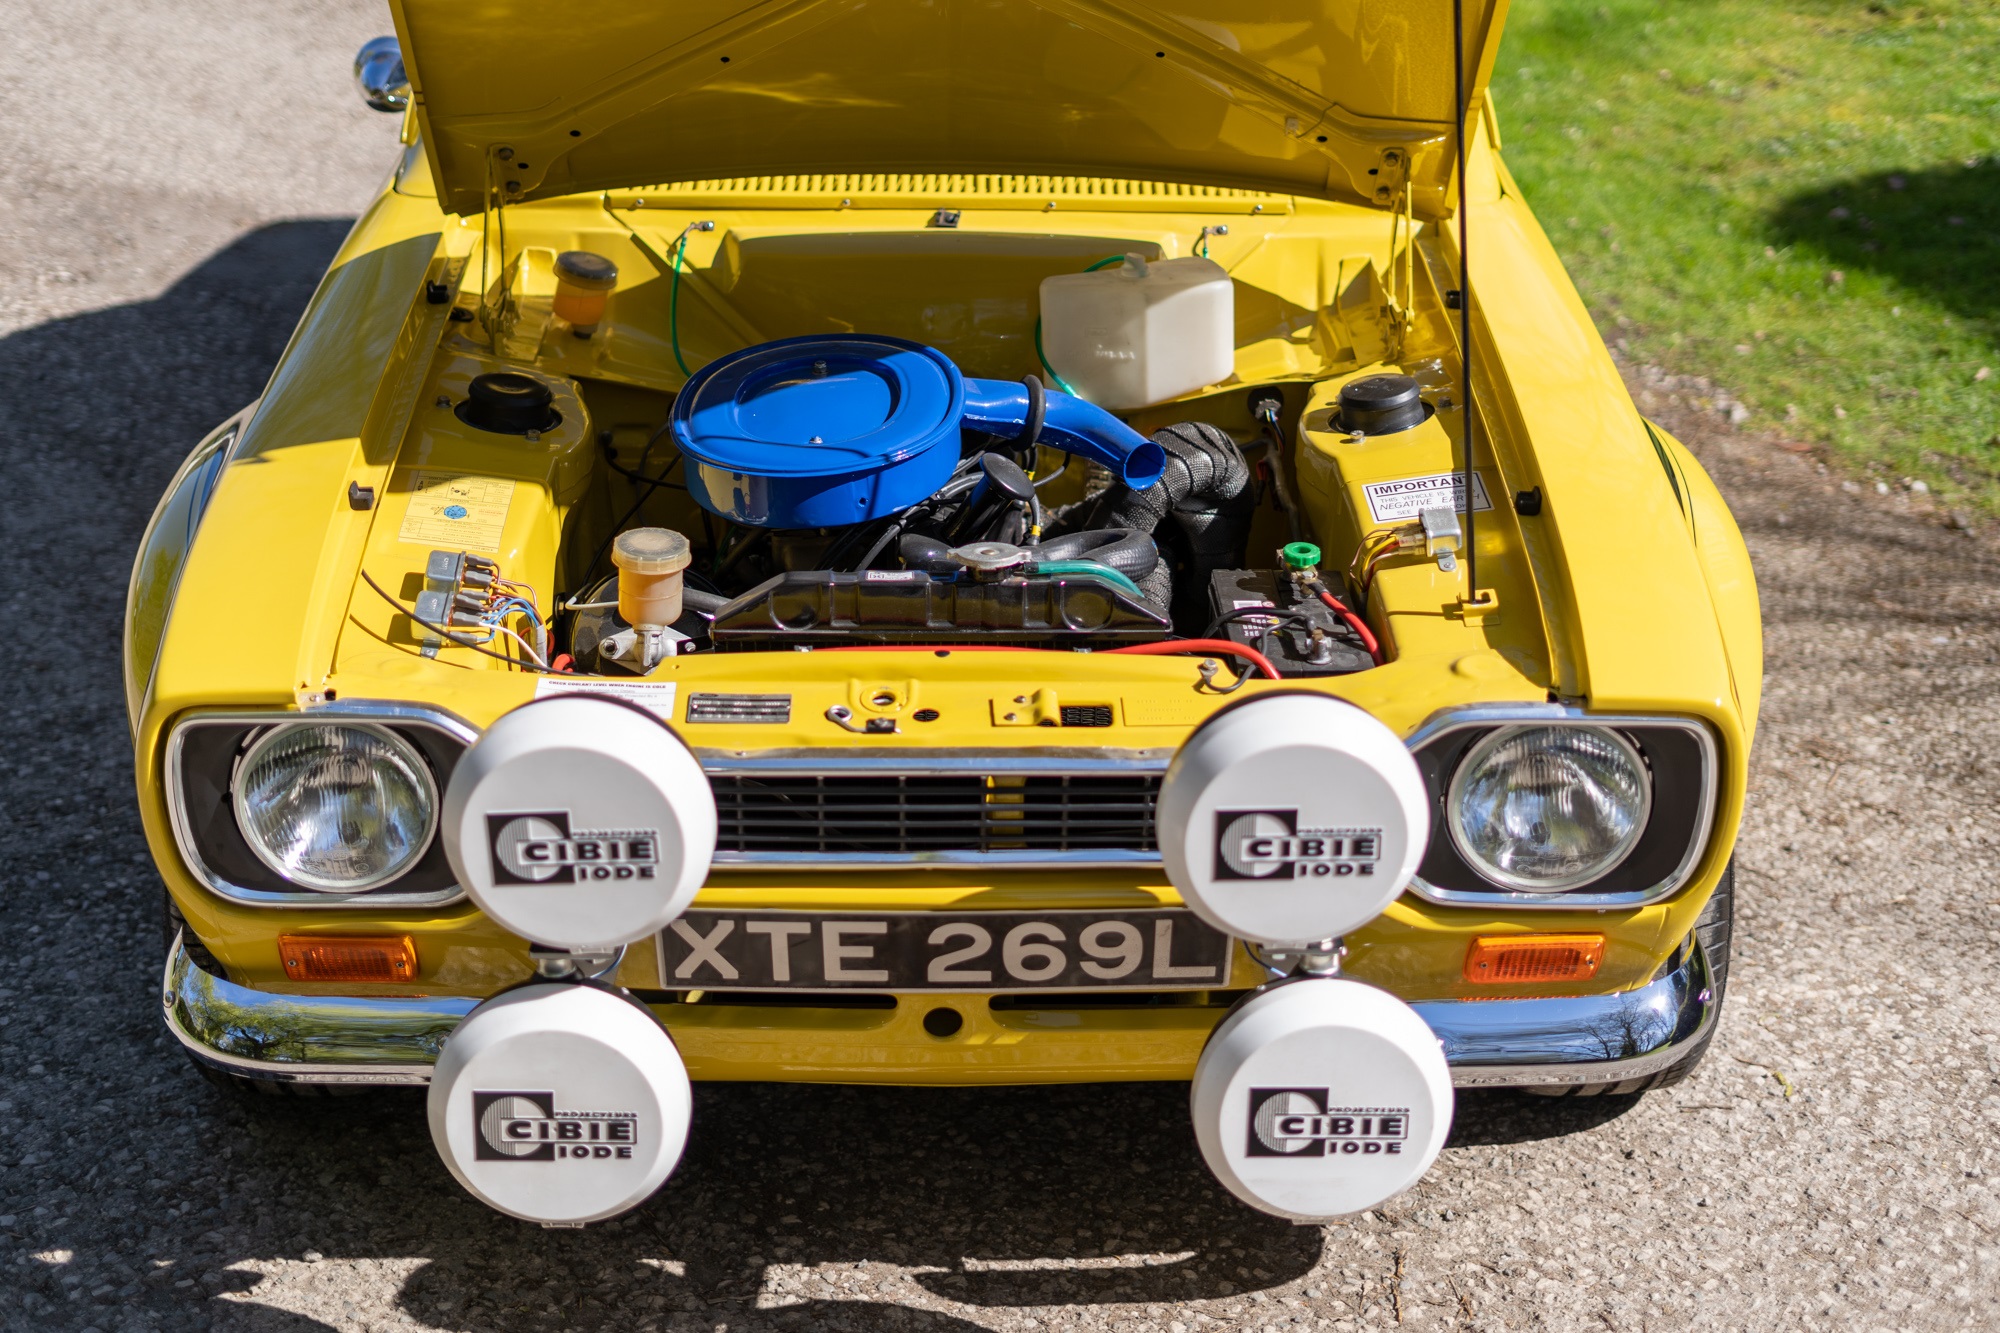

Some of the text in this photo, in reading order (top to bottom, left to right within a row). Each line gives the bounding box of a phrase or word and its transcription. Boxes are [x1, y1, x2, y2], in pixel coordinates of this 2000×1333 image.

[1380, 498, 1433, 511] NEGATIVE
[1403, 493, 1434, 502] VEHICLE
[579, 866, 655, 881] IODE
[1298, 863, 1375, 877] IODE
[670, 919, 1217, 982] XTE 269L
[558, 1145, 632, 1159] IODE
[1328, 1141, 1402, 1155] IODE
